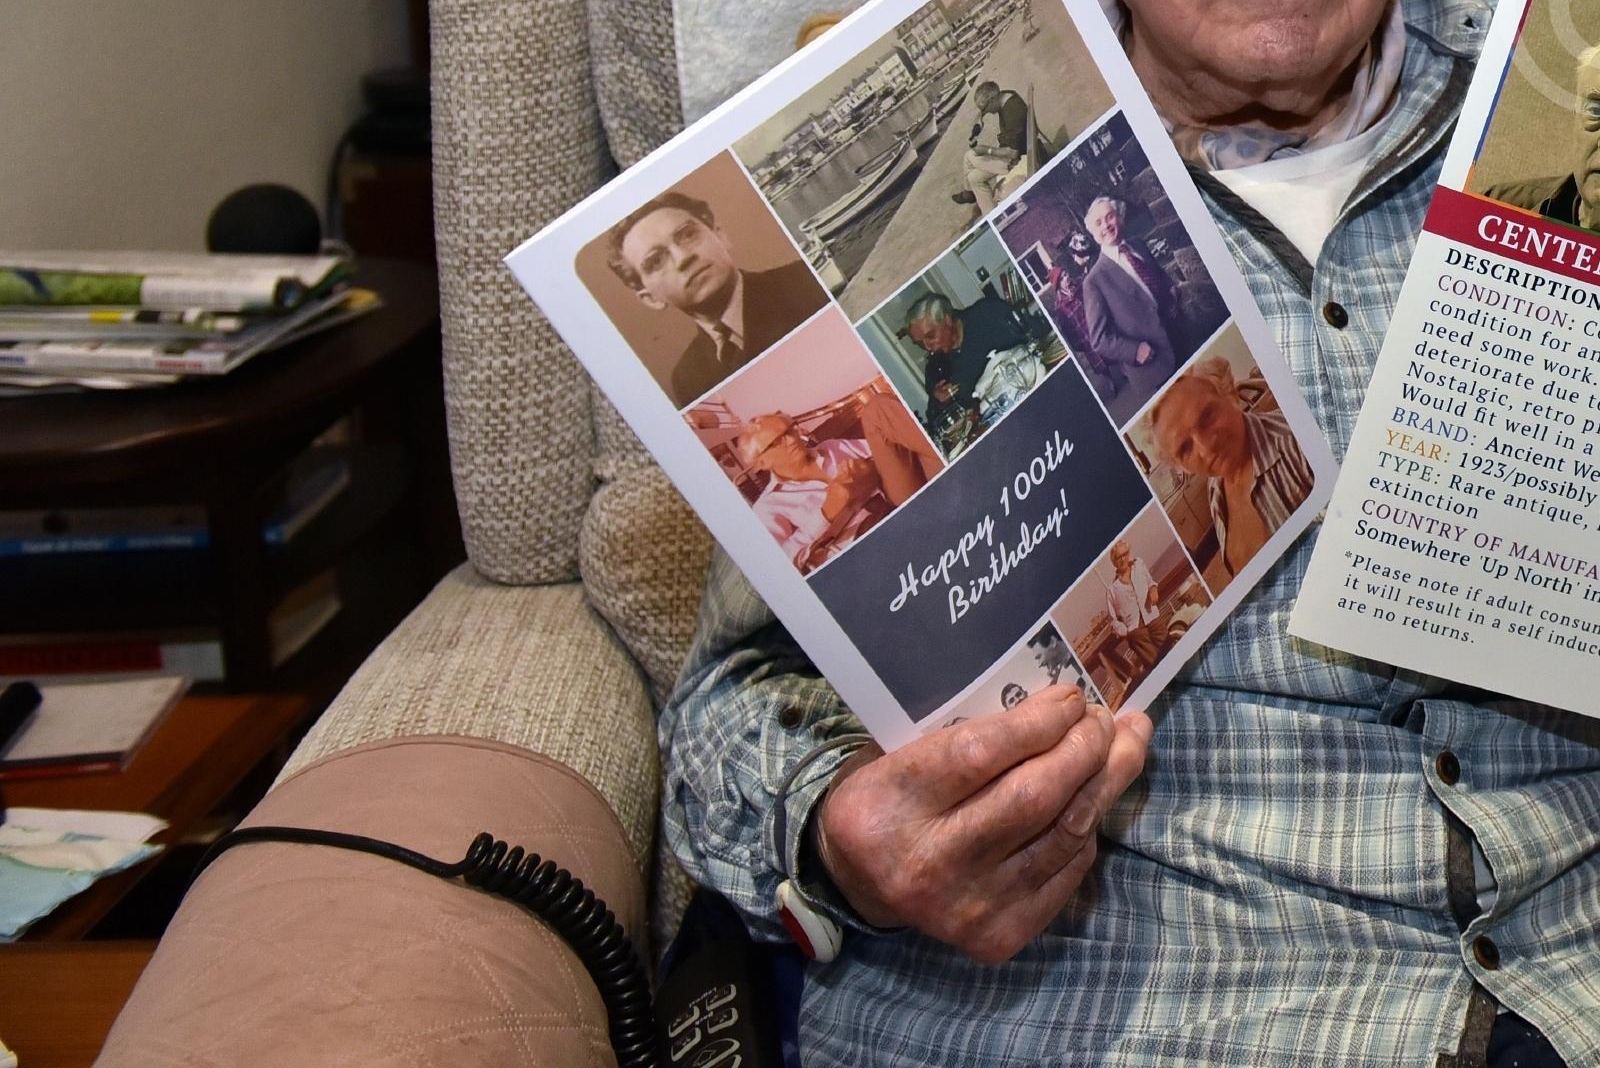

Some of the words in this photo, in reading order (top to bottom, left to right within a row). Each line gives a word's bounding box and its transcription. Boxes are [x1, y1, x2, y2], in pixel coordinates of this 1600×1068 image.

[1429, 299, 1532, 343] condition
[1539, 330, 1572, 353] for
[1437, 274, 1576, 331] CONDITION:
[1414, 340, 1535, 391] deteriorate
[1542, 380, 1580, 404] due
[1421, 321, 1474, 348] need
[1479, 340, 1535, 367] some
[1543, 358, 1598, 387] work.
[1402, 382, 1468, 418] Would
[1472, 406, 1498, 427] fit
[1505, 418, 1549, 442] well
[1553, 430, 1575, 451] in
[1582, 442, 1594, 456] a
[1405, 360, 1513, 412] Nostalgic,
[1521, 400, 1576, 426] retro
[1386, 428, 1451, 464] YEAR:
[1458, 452, 1599, 508] 1923/possibly
[1391, 406, 1477, 447] BRAND:
[1483, 436, 1567, 473] Ancient
[889, 514, 995, 613] Happy
[999, 430, 1074, 517] 100th
[1369, 476, 1479, 520] extinction
[1378, 450, 1441, 485] TYPE:
[1447, 473, 1496, 501] Rare
[1503, 493, 1588, 531] antique,
[948, 487, 1069, 625] Birthday!
[1354, 519, 1471, 567] Somewhere
[1361, 498, 1469, 543] COUNTRY
[1473, 532, 1503, 552] OF
[1337, 597, 1367, 614] are
[1372, 607, 1396, 622] no
[1401, 615, 1474, 644] returns.
[1343, 573, 1360, 591] it
[1366, 583, 1402, 602] will
[1405, 595, 1462, 619] result
[1466, 607, 1485, 625] in
[1491, 618, 1501, 629] a
[1507, 622, 1545, 640] self
[1417, 576, 1459, 597] note
[1465, 586, 1484, 602] if
[1485, 595, 1534, 617] adult
